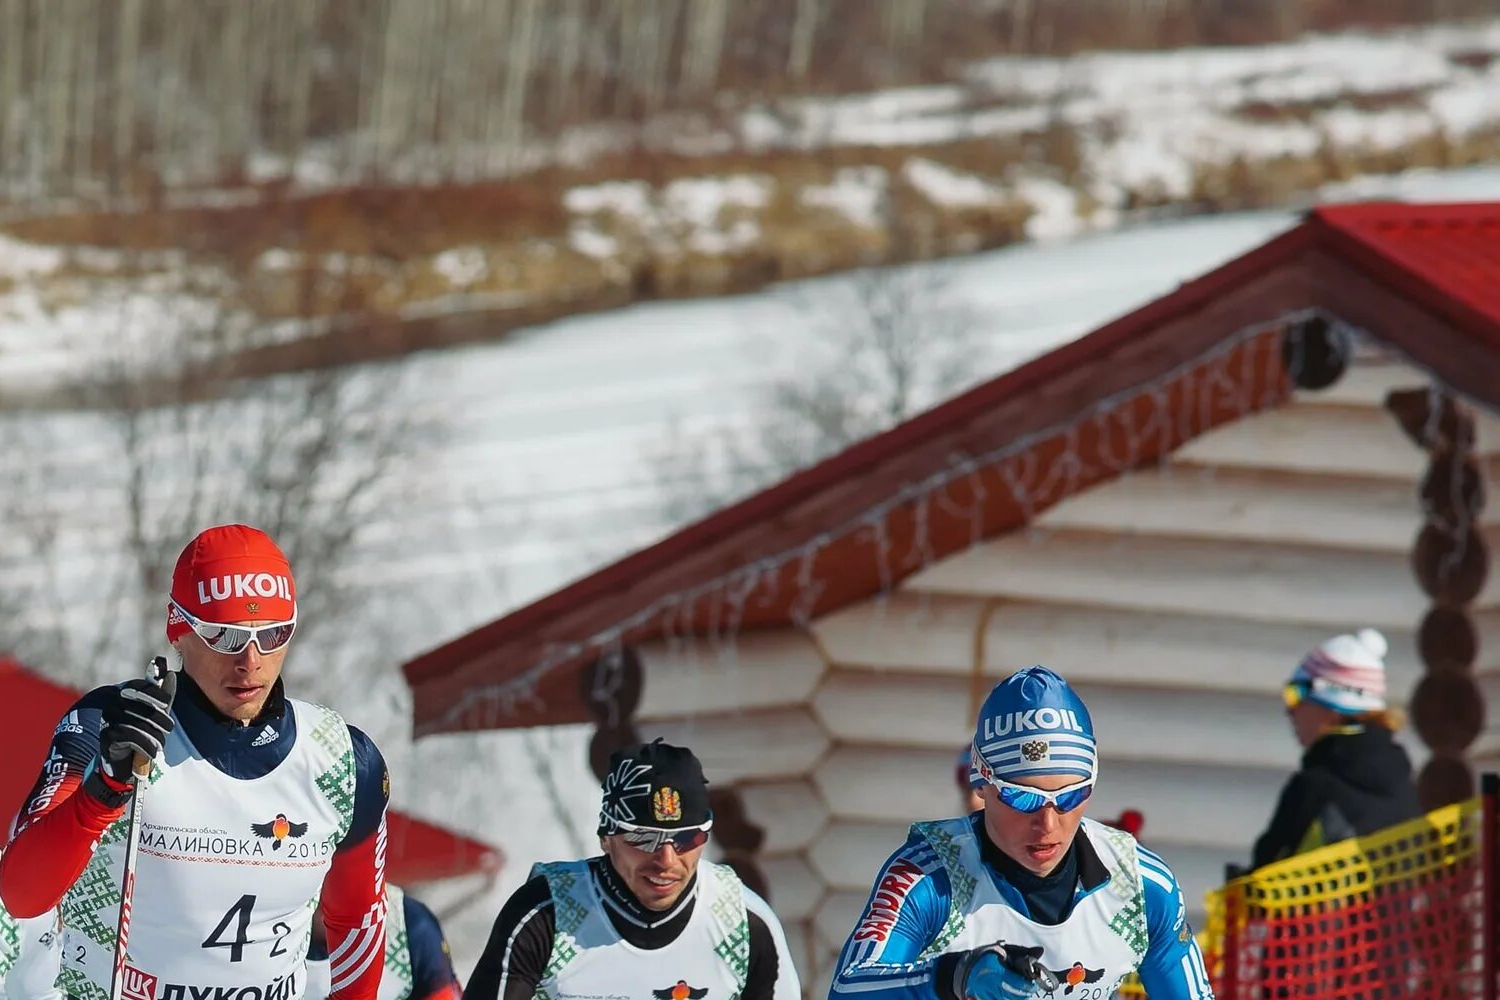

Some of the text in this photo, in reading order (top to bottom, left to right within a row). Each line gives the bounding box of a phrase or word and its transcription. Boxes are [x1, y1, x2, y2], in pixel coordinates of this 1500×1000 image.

[198, 573, 292, 604] LUKOIL
[251, 731, 280, 747] adidas
[984, 707, 1083, 741] LUKOIL
[138, 831, 329, 858] МАЛИНОВКА 2015
[854, 858, 924, 945] SATURN
[202, 894, 257, 963] 4
